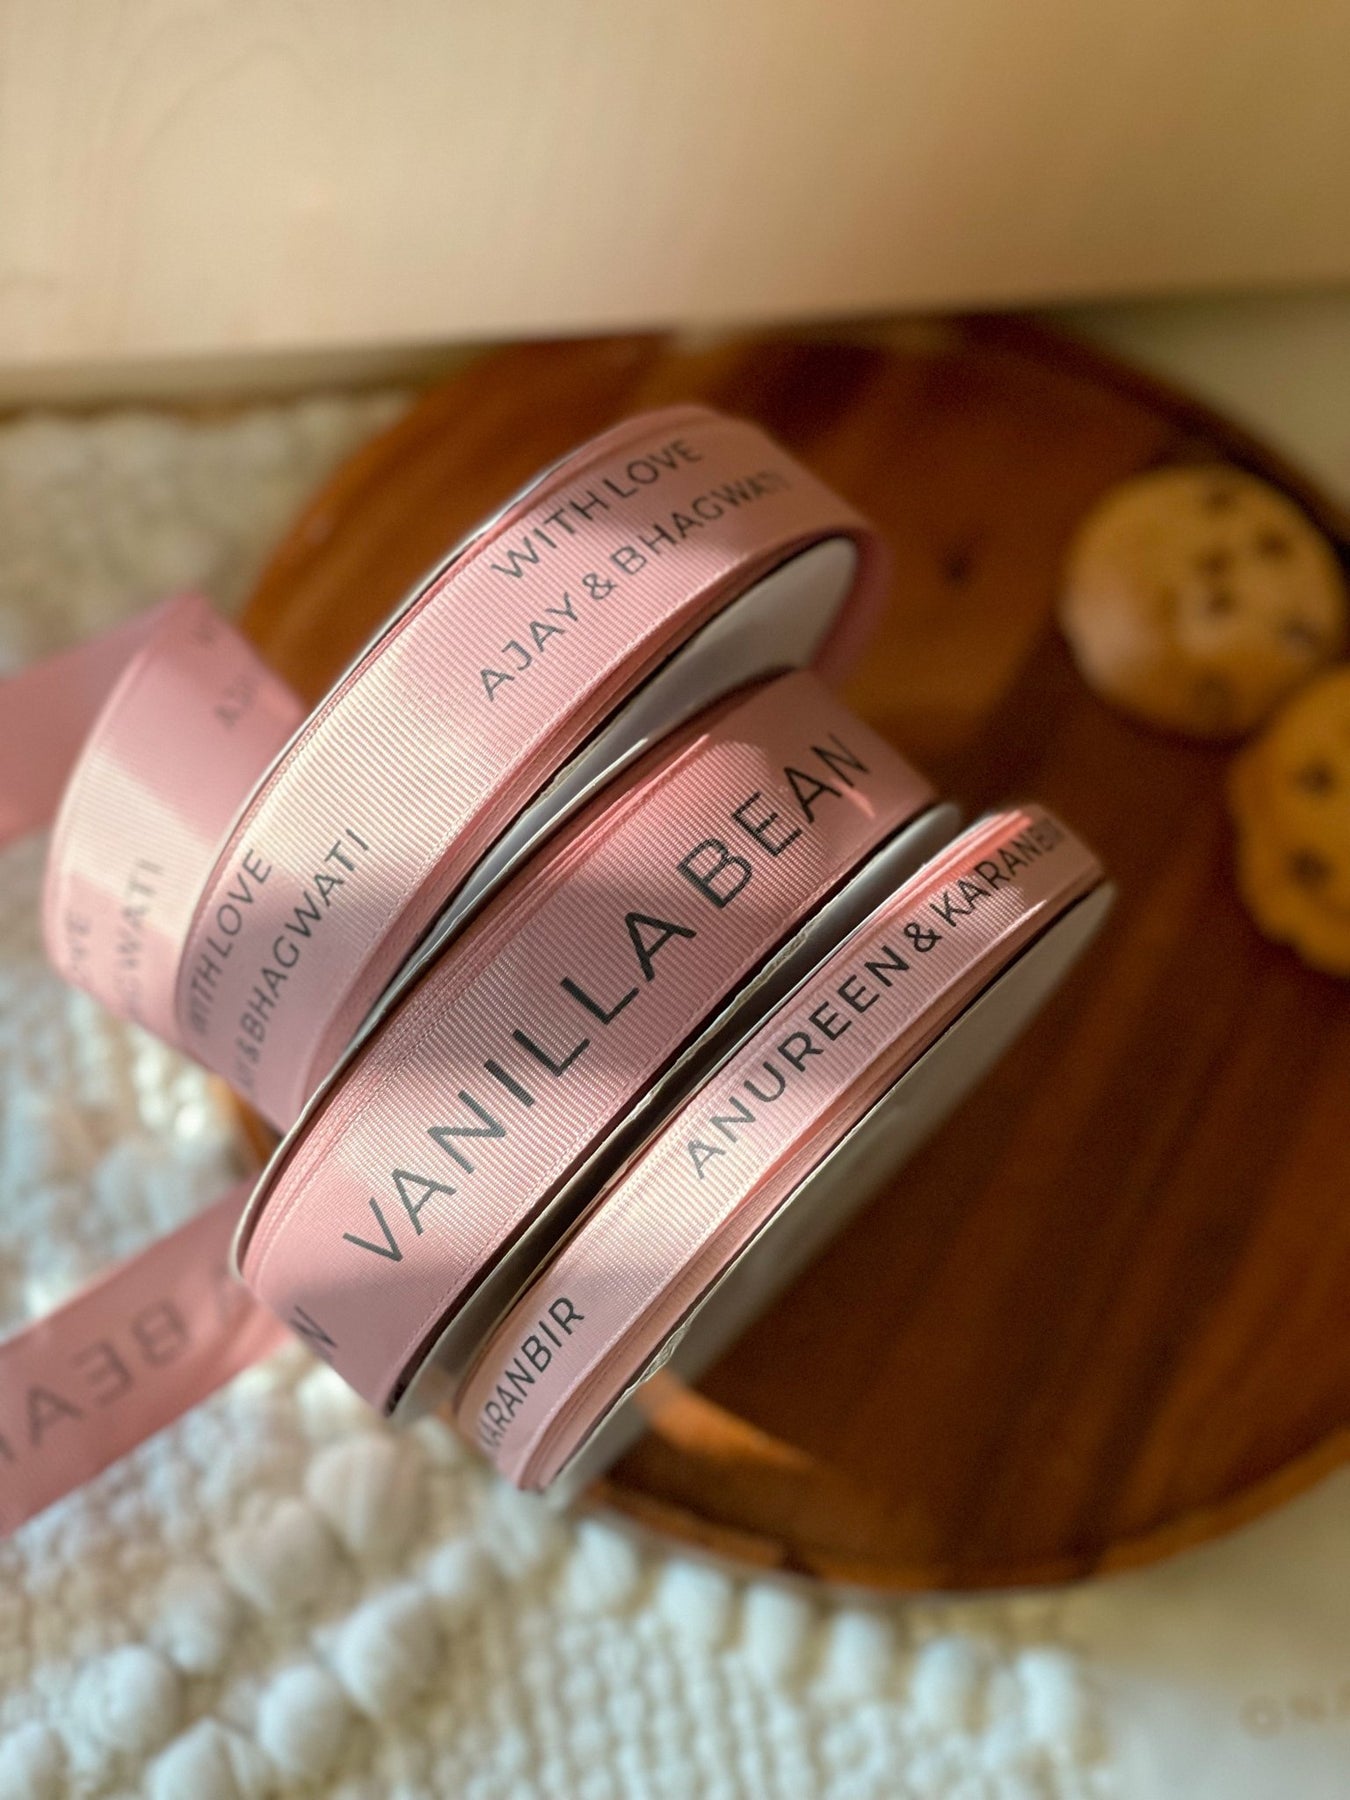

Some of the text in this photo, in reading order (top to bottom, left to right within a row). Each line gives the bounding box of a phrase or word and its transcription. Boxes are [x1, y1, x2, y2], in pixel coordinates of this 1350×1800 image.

[491, 439, 704, 580] WITH LOVE
[478, 592, 580, 701] AJAY
[582, 572, 618, 601] &
[240, 828, 370, 1043] BHAGWATI
[342, 733, 871, 1263] VANILLA BEAN
[686, 945, 910, 1180] ANUREEN
[903, 921, 944, 953] &
